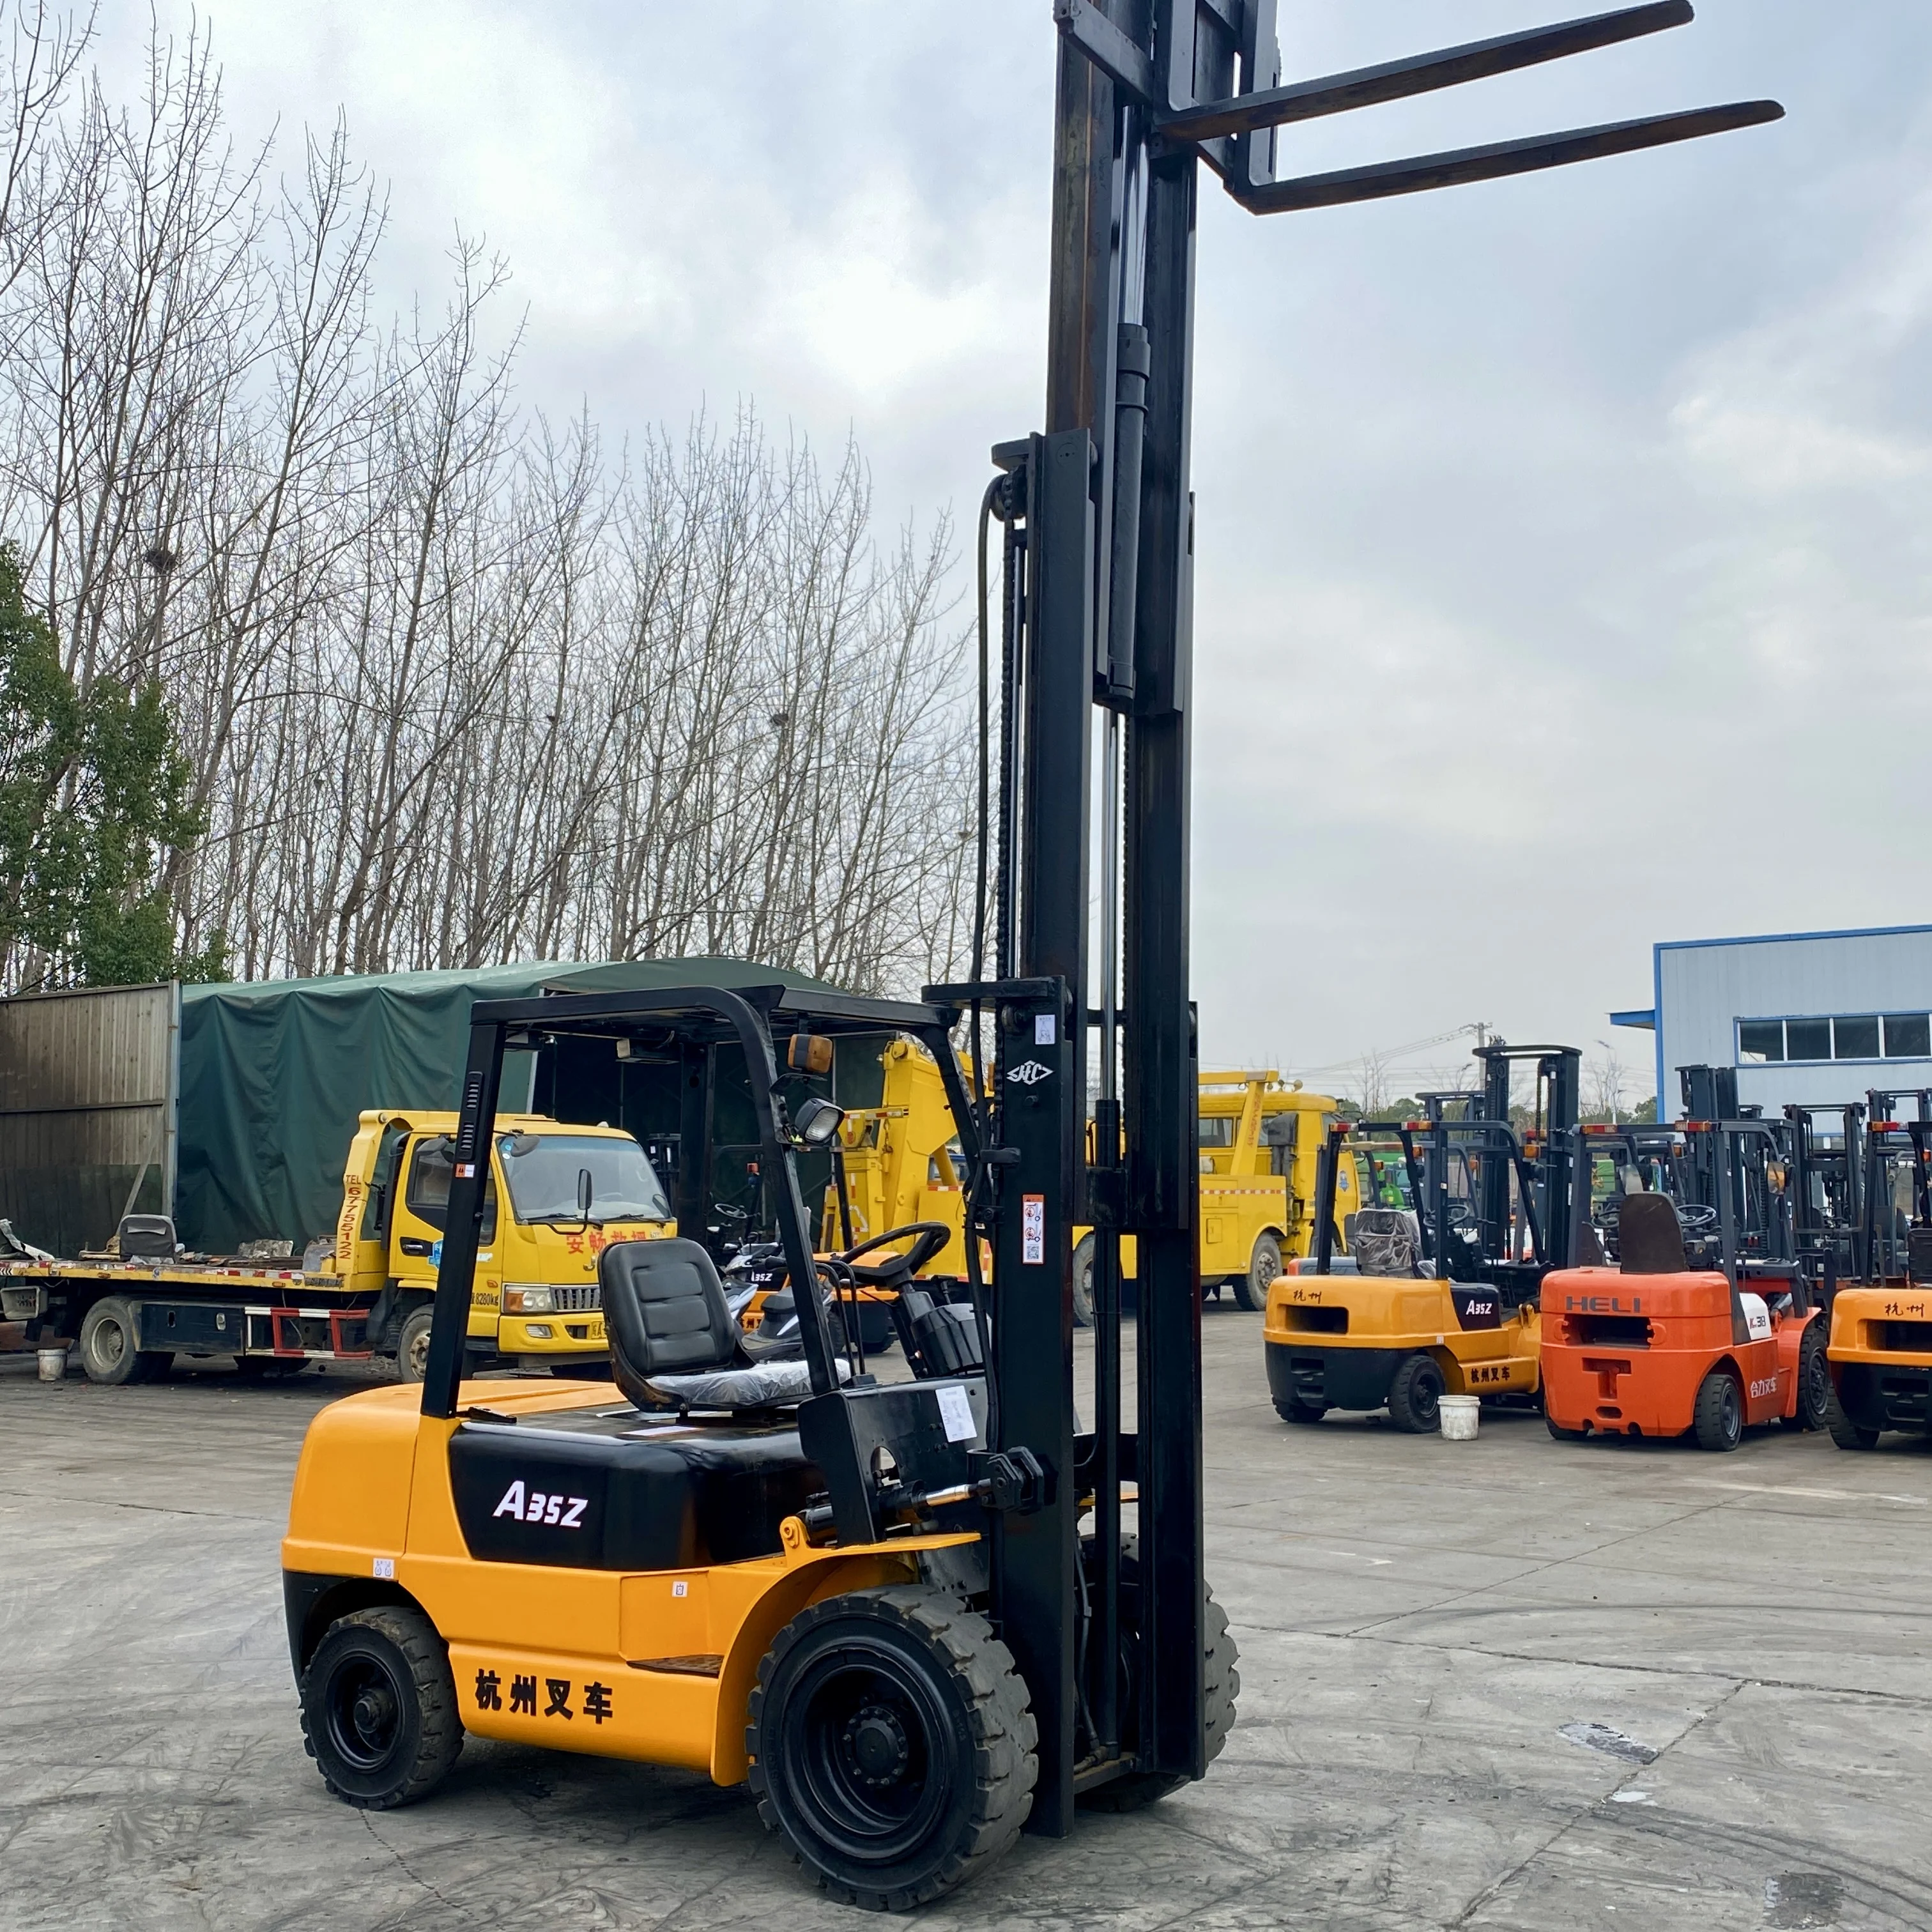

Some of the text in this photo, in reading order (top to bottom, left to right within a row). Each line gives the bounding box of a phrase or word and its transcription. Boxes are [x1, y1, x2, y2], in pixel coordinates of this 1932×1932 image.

[346, 1175, 362, 1184] TEL
[338, 1187, 362, 1259] 67755122
[1466, 1300, 1492, 1315] A35Z
[1567, 1296, 1640, 1313] HELI
[1471, 1366, 1510, 1383] 杭州叉车
[493, 1480, 588, 1528] A35Z
[475, 1668, 613, 1724] 杭州叉车
